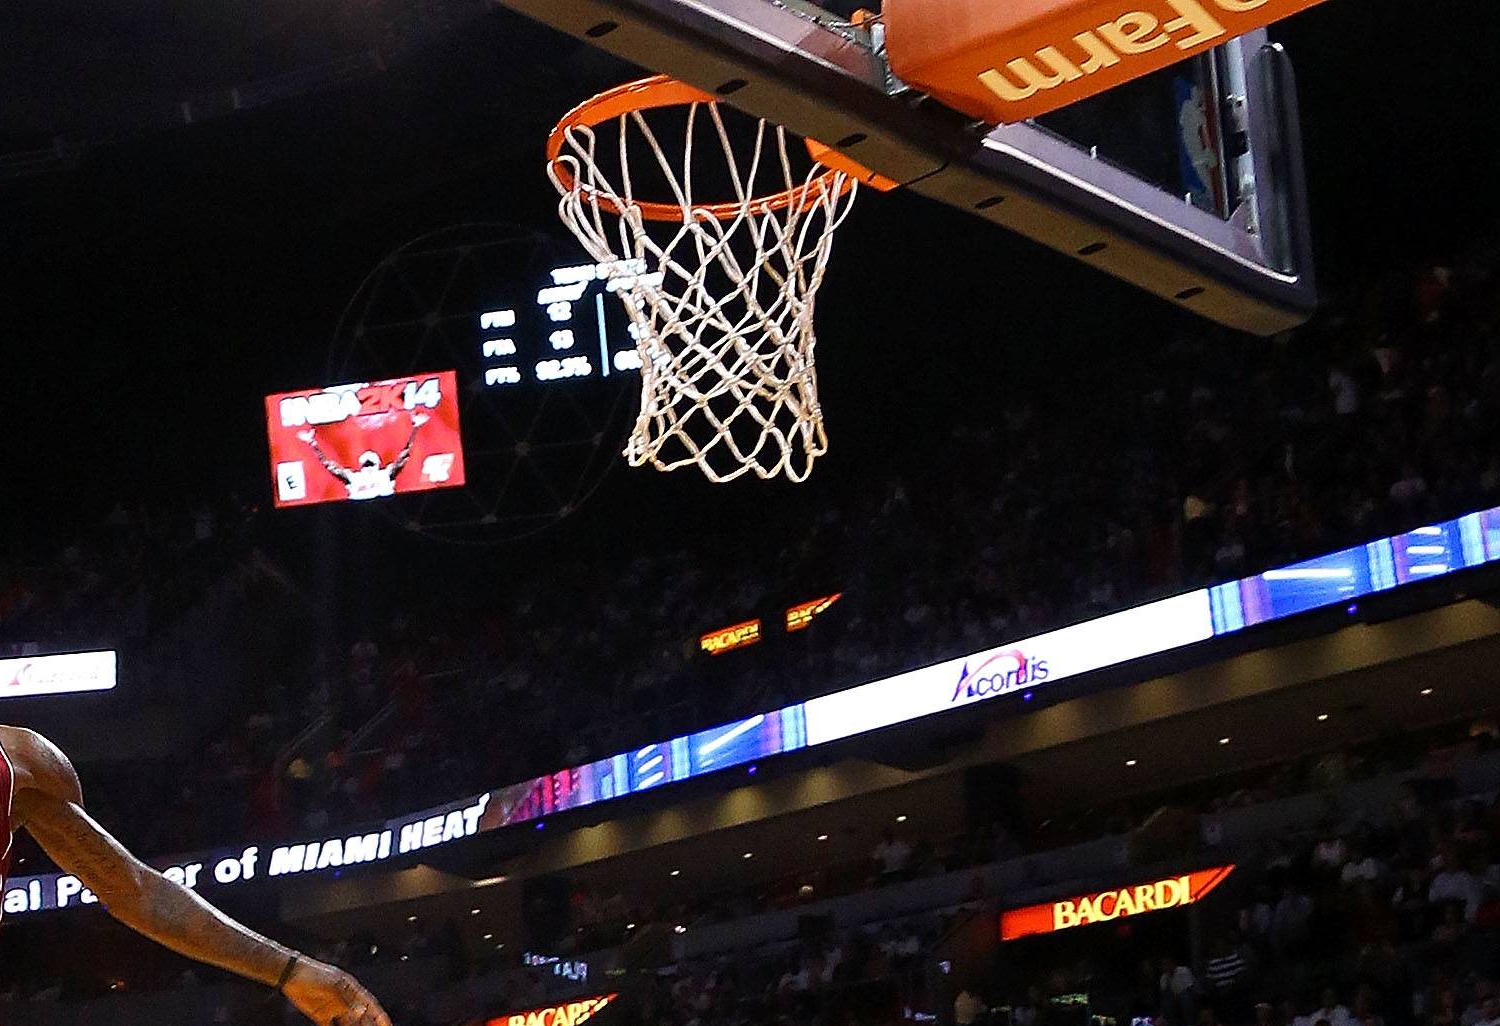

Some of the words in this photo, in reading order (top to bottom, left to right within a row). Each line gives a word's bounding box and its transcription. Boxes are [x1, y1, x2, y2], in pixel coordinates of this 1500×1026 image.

[977, 0, 1227, 101] Farm
[213, 846, 258, 884] of
[268, 830, 392, 876] MIAMI
[399, 792, 491, 853] HEAT
[1053, 875, 1192, 931] BACARDI
